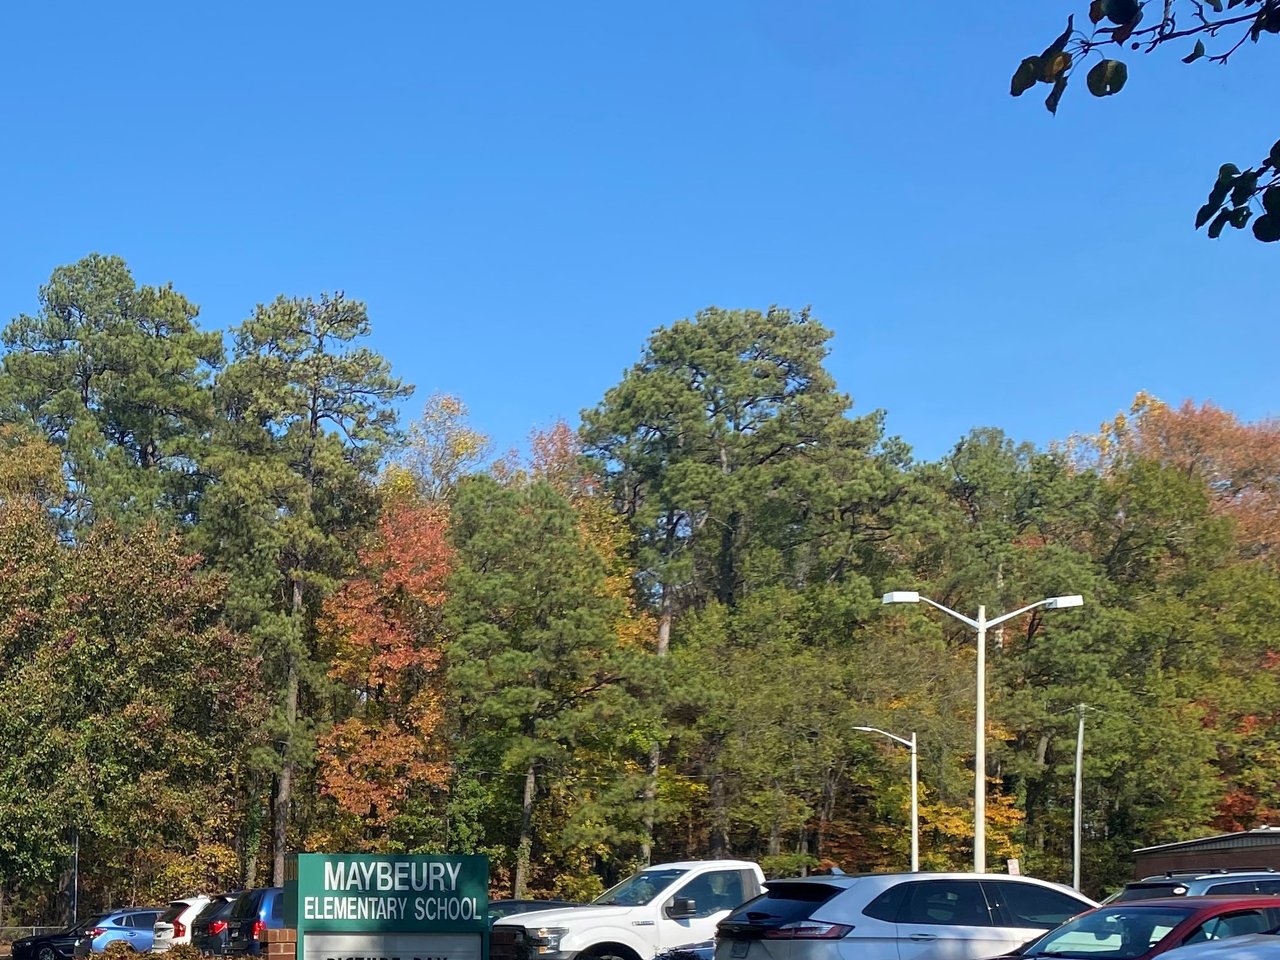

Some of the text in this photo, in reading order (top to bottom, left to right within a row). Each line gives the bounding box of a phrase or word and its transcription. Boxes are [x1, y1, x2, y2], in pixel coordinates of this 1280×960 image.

[324, 861, 462, 891] MAYBEURY
[304, 896, 482, 921] ELEMENTARY SCHOOL
